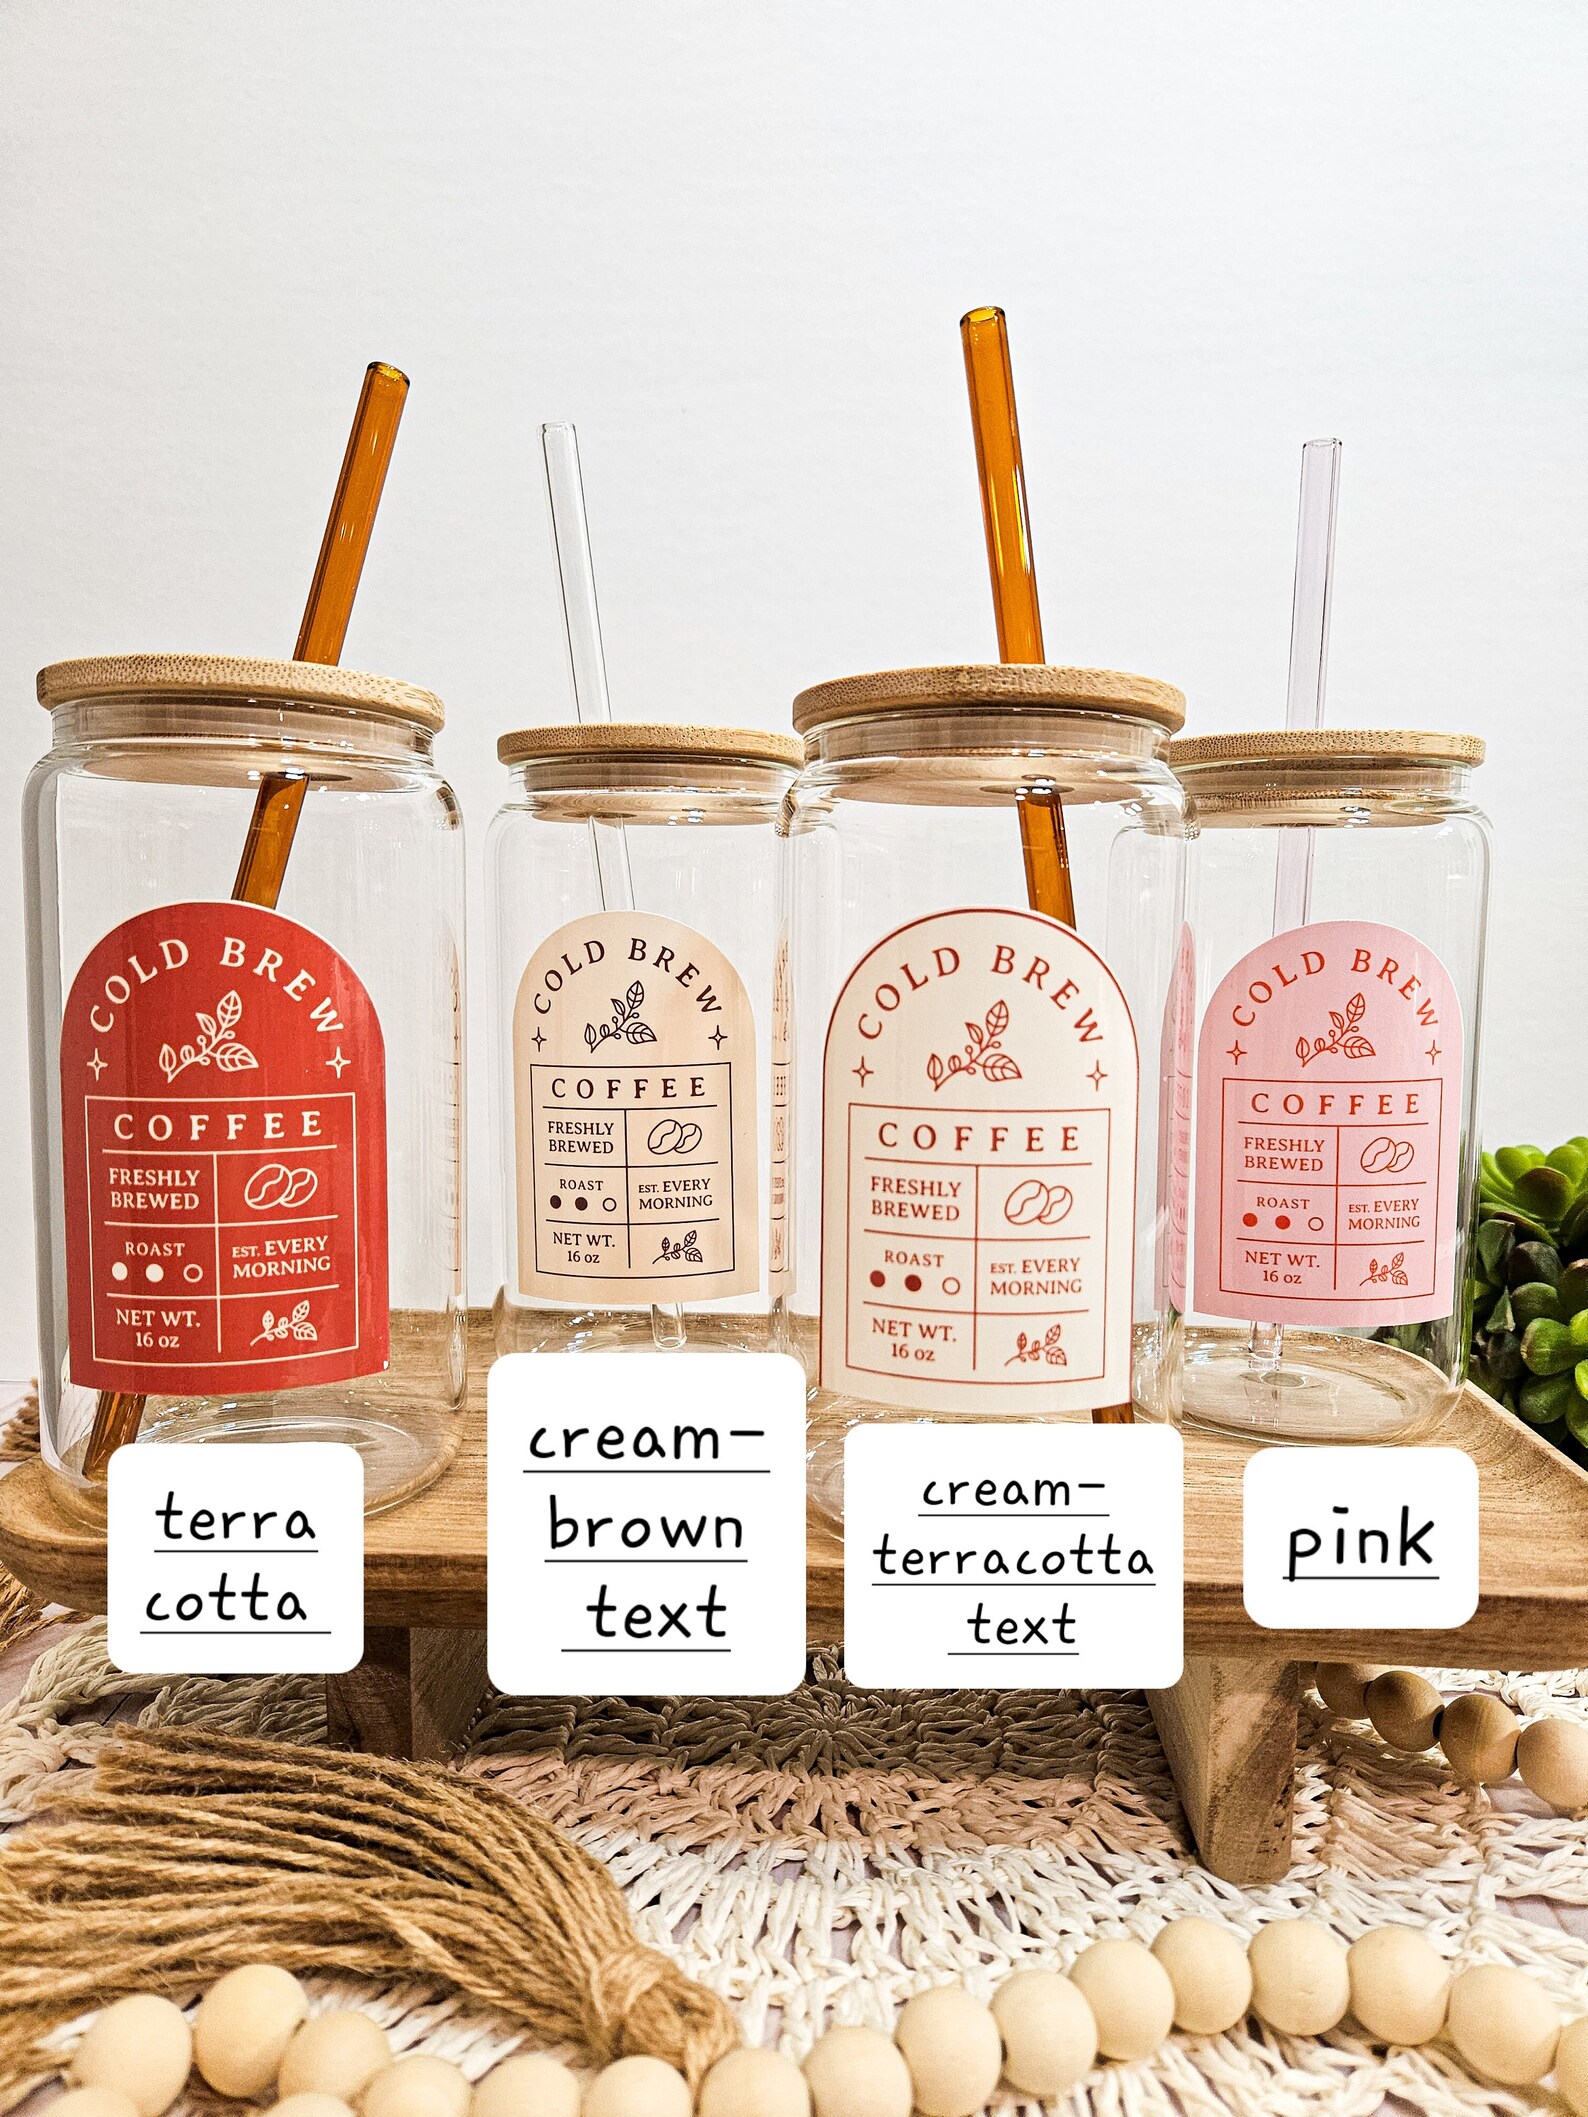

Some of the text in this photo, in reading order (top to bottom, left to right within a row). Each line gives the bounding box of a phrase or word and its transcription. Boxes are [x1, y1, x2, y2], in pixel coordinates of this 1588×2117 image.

[534, 937, 722, 1015] COLD BREW
[91, 937, 344, 1034] COLD BREW
[1232, 949, 1439, 1028] COLD BREW
[858, 945, 1104, 1044] COLD BREW
[552, 1077, 705, 1099] COFFEE
[1251, 1093, 1420, 1115] COFFEE
[114, 1110, 321, 1141] COFFEE
[547, 1120, 614, 1136] FRESHLY
[878, 1122, 1079, 1153] COFFEE
[1244, 1137, 1325, 1153] FRESHLY
[549, 1139, 614, 1154] BREWED
[1245, 1155, 1324, 1172] BREWED
[109, 1167, 200, 1188] FRESHLY
[559, 1179, 604, 1191] ROAST
[638, 1178, 710, 1193] EST. EVERY
[870, 1176, 961, 1198] FRESHLY
[111, 1191, 199, 1210] BREWED
[639, 1194, 713, 1209] MORNING
[1256, 1196, 1310, 1210] ROAST
[1348, 1199, 1420, 1213] EST. EVERY
[871, 1201, 960, 1221] BREWED
[1348, 1215, 1421, 1231] MORNING
[232, 1236, 328, 1258] EST. EVERY
[553, 1232, 616, 1247] NET WT.
[124, 1241, 185, 1257] ROAST
[568, 1250, 600, 1264] 16 oz
[884, 1249, 945, 1267] ROAST
[990, 1257, 1081, 1274] EST. EVERY
[1245, 1251, 1320, 1268] NET WT.
[233, 1257, 331, 1278] MORNING
[1263, 1270, 1302, 1284] 16 oz
[990, 1278, 1082, 1295] MORNING
[116, 1310, 200, 1328] NET WT.
[872, 1318, 957, 1342] NET WT.
[136, 1332, 180, 1348] 16 oz
[891, 1343, 935, 1362] 16 oz
